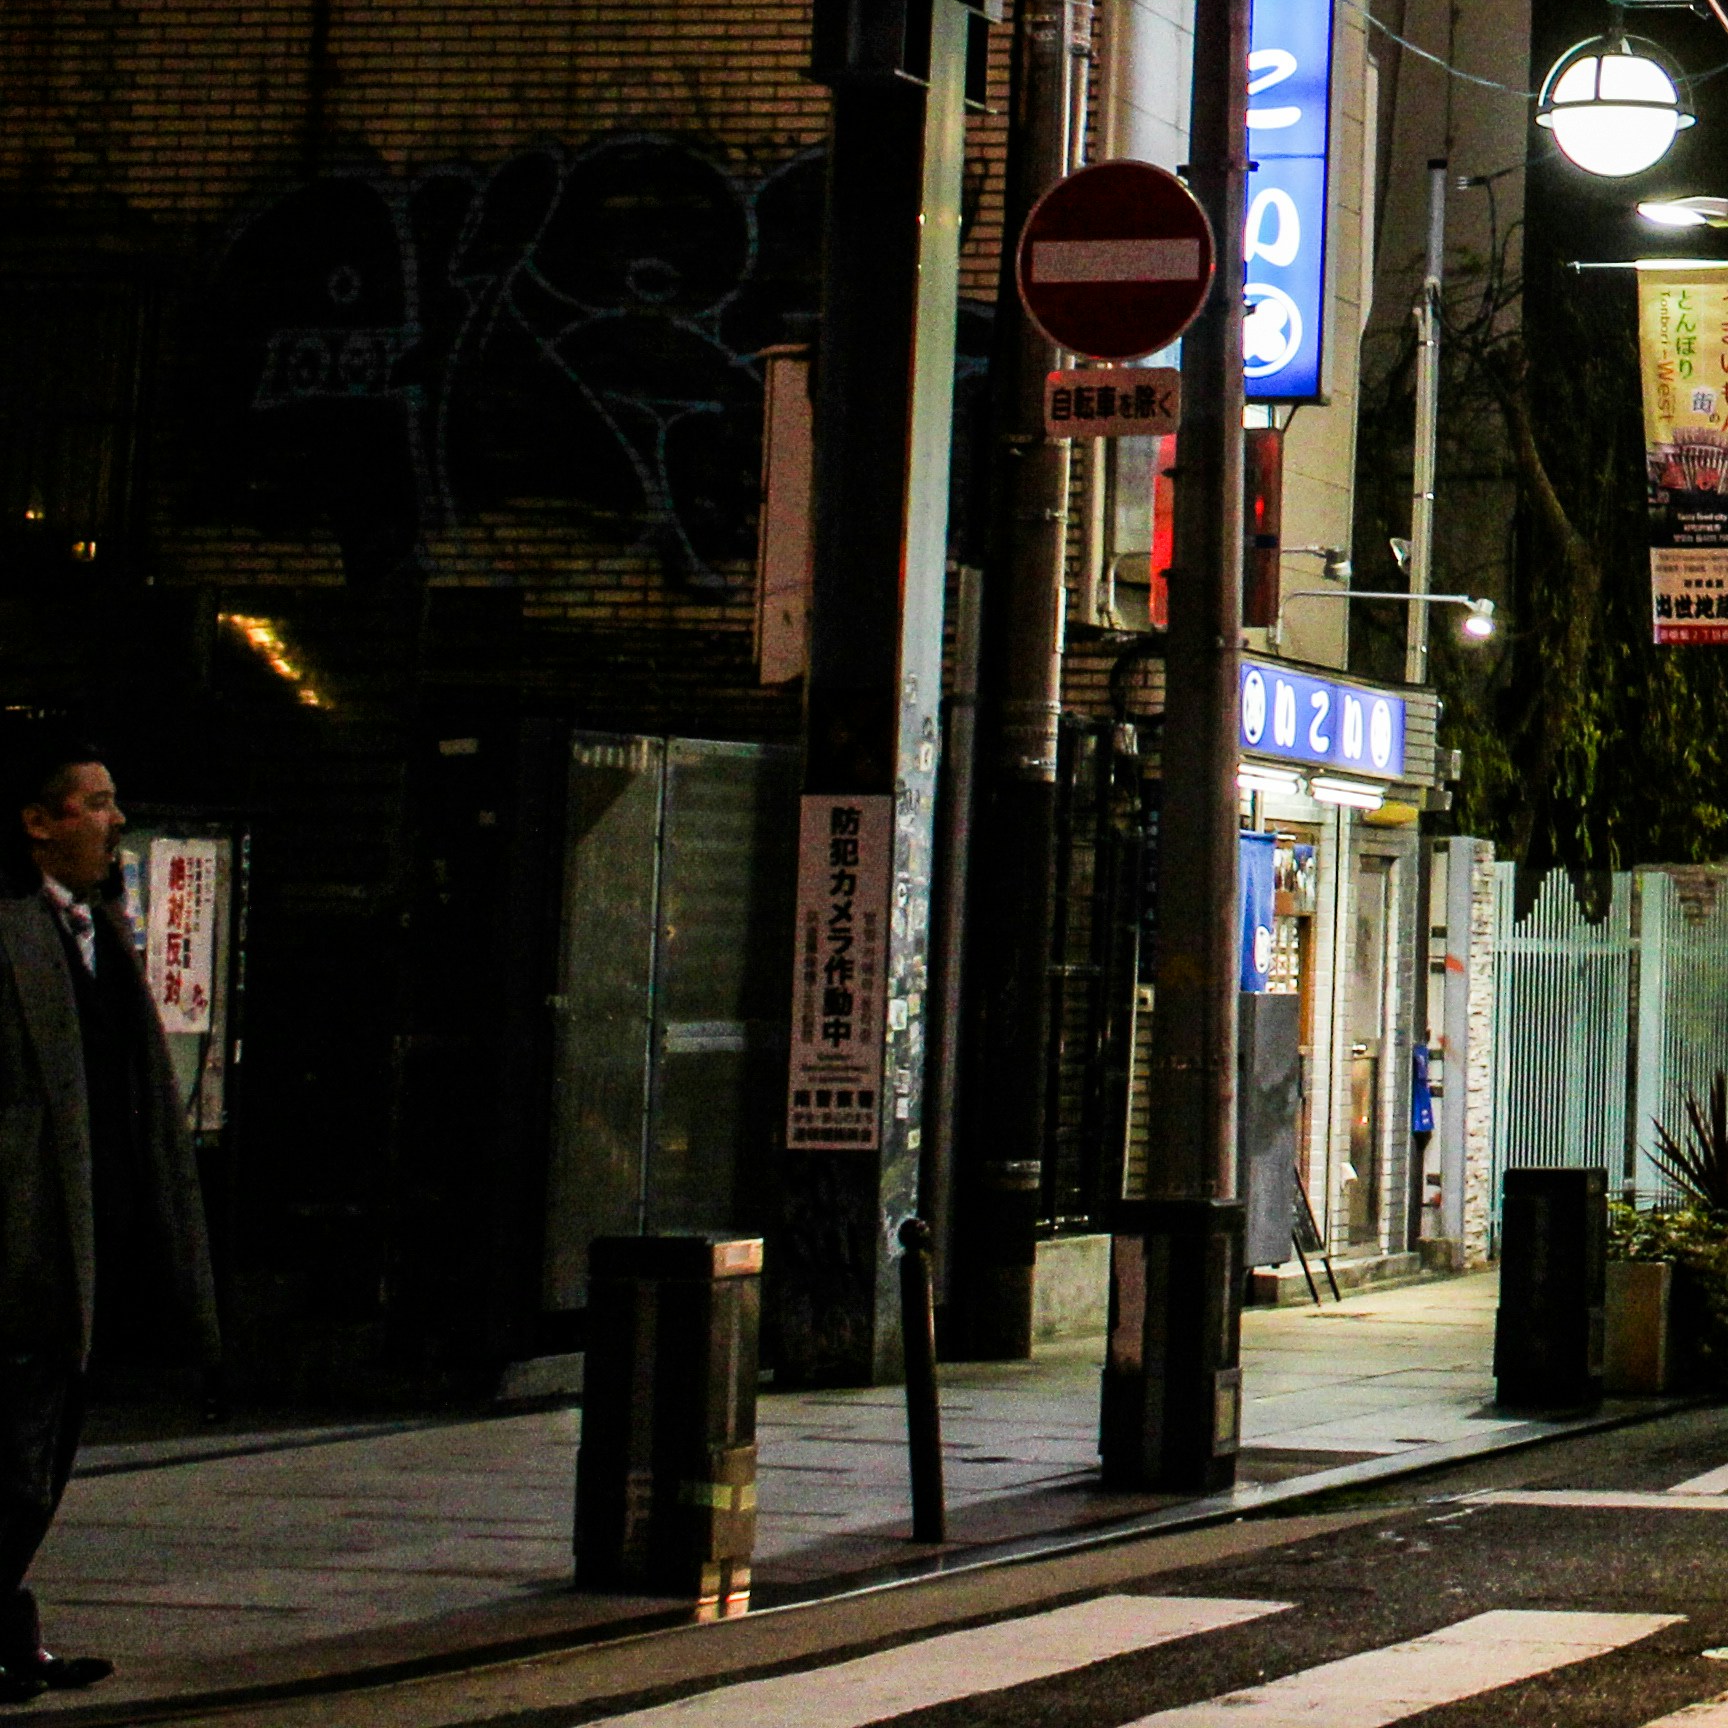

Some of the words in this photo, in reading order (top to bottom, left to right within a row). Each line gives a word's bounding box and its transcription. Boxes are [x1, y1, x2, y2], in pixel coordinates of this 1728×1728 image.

[1675, 289, 1697, 380] とんぼり
[1050, 386, 1173, 424] 自転車を除く
[821, 805, 863, 1048] 防犯カメラ作動中
